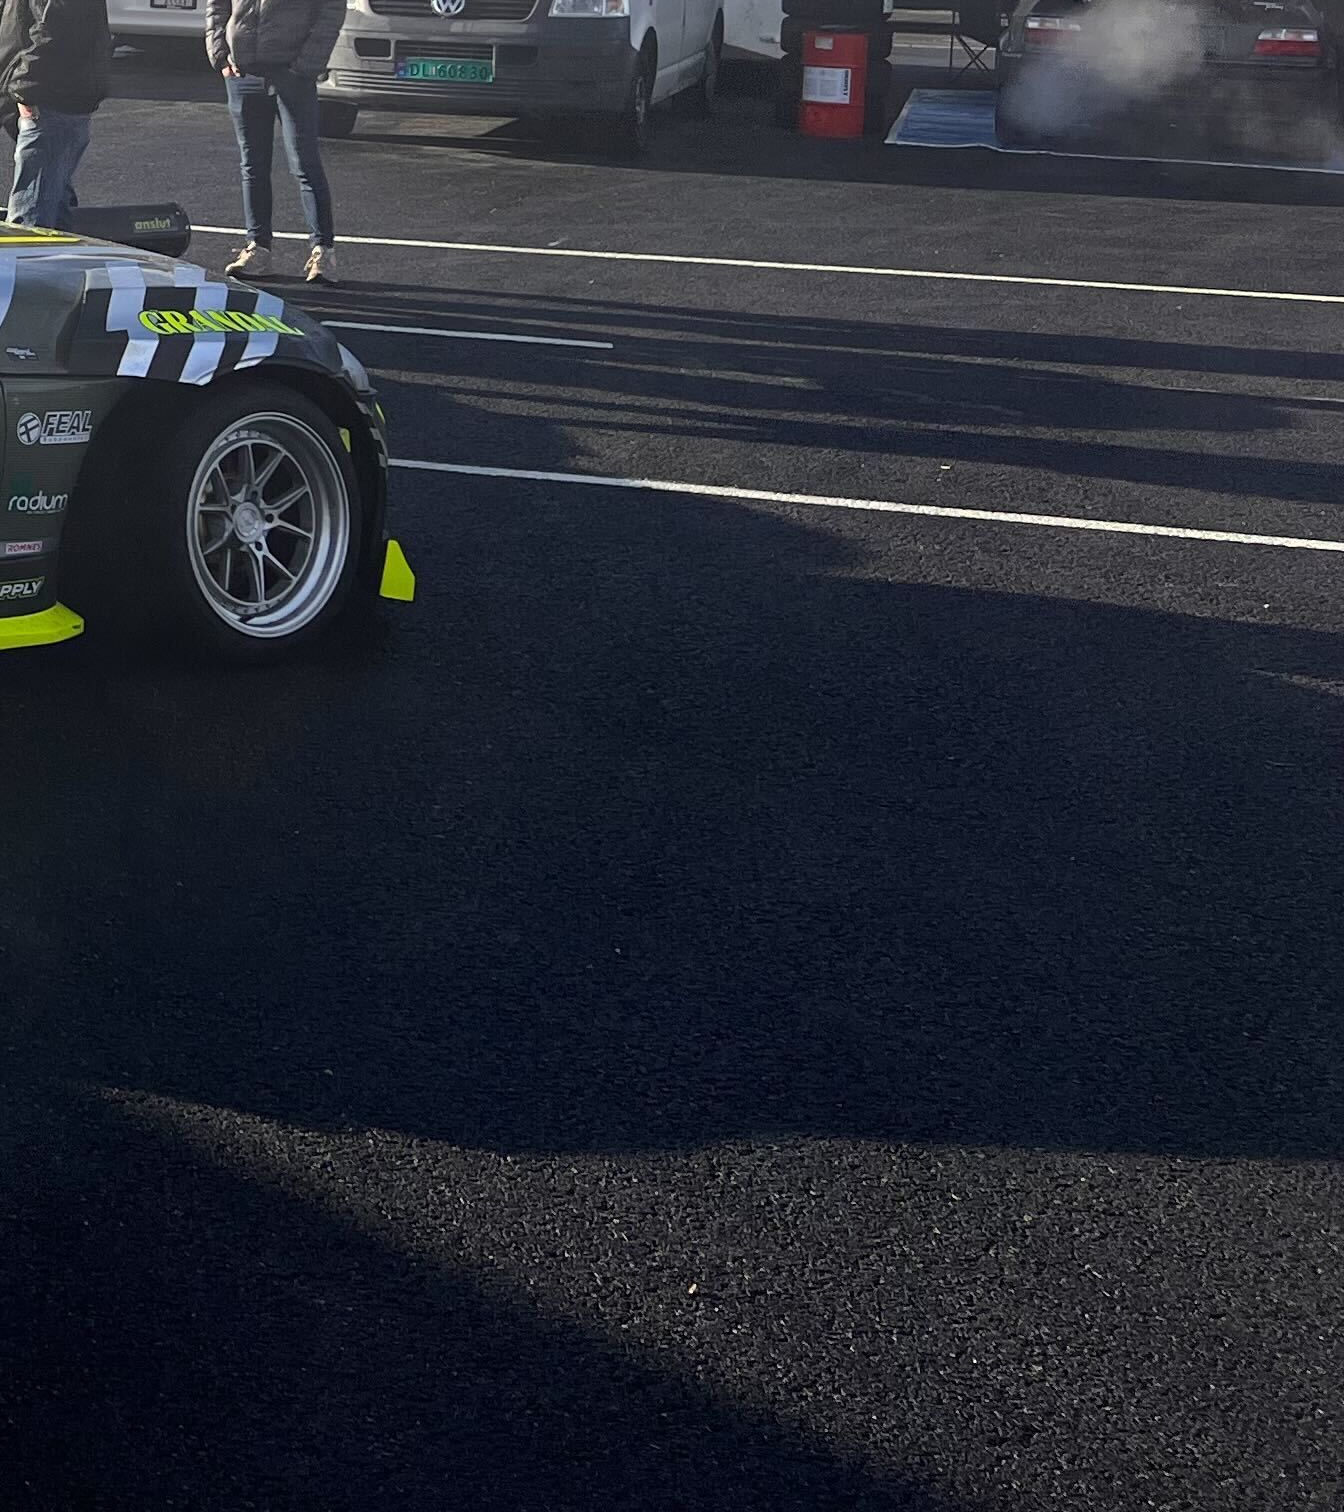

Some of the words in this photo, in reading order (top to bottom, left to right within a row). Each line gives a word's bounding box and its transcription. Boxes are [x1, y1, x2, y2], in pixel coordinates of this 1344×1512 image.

[409, 63, 430, 77] DL
[42, 410, 92, 436] FEAL
[8, 490, 68, 511] radium
